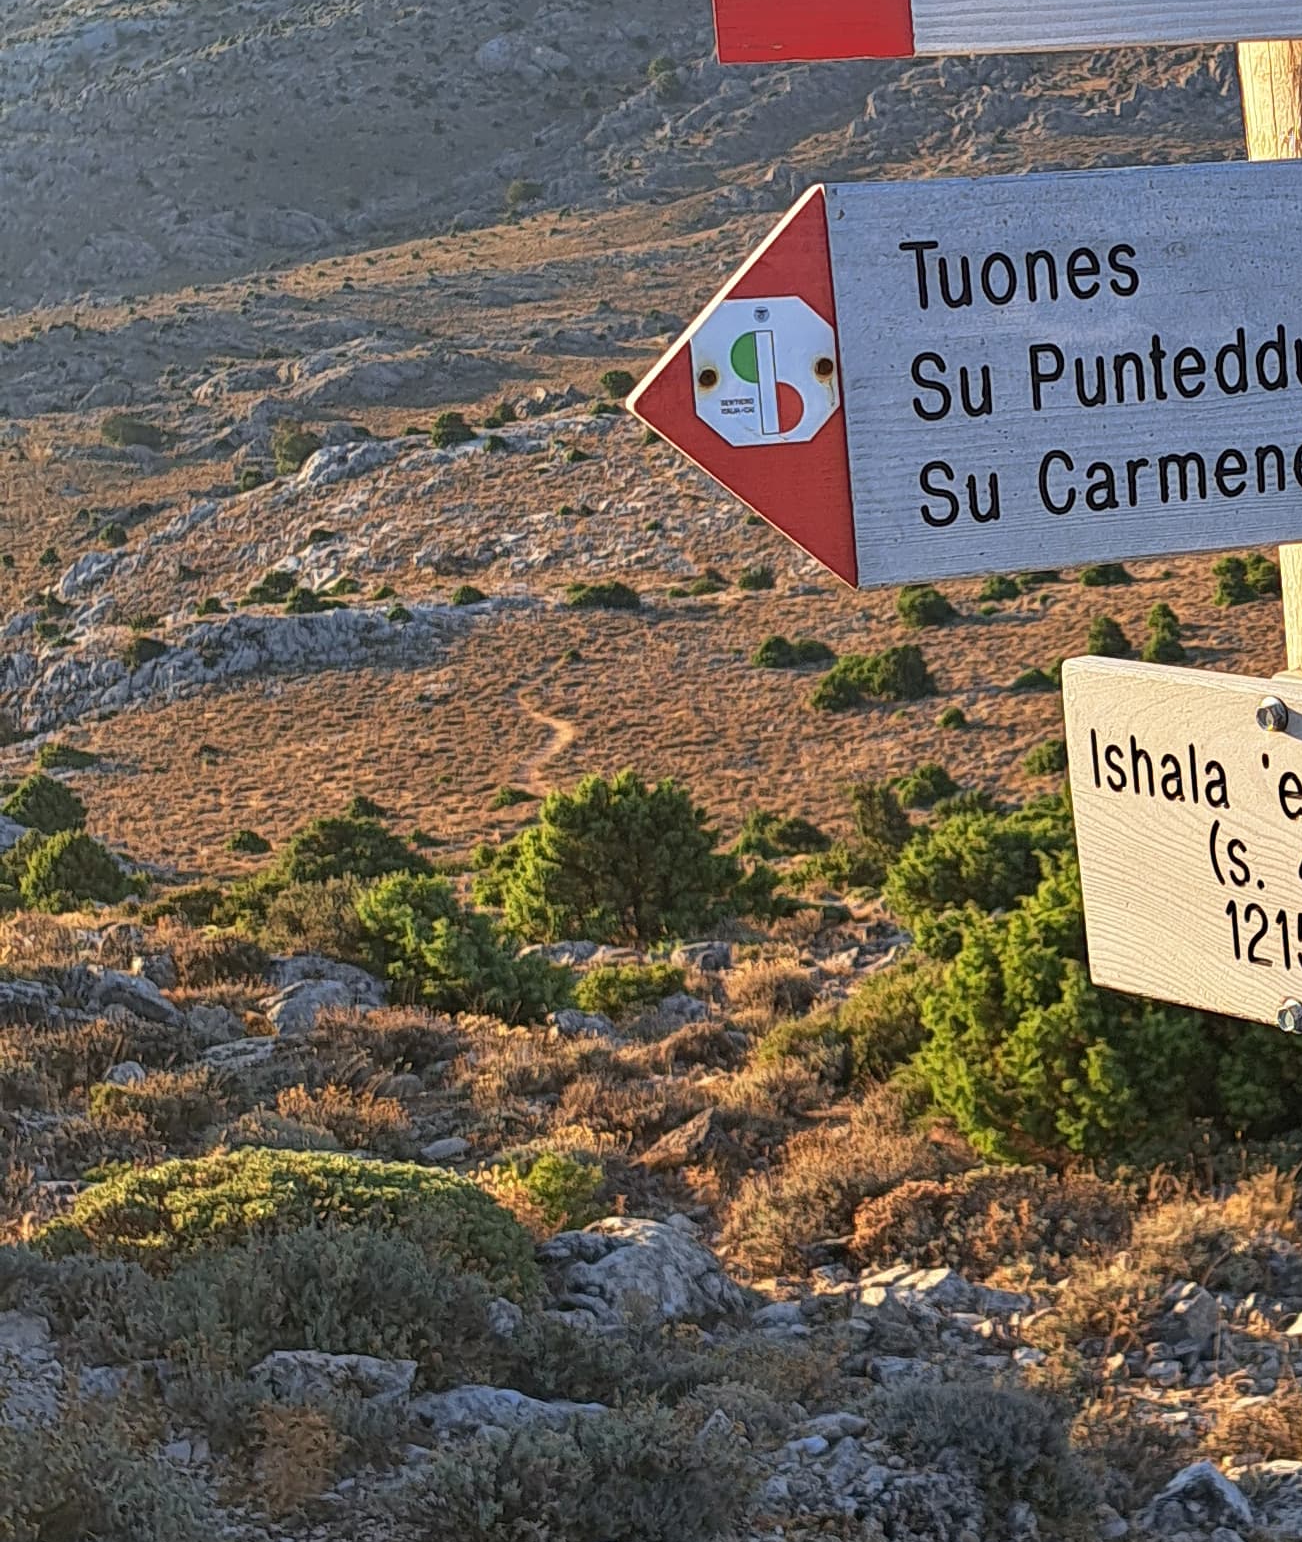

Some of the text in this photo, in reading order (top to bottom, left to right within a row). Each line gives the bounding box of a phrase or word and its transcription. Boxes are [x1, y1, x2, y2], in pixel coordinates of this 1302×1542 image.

[899, 240, 1140, 310] Tuones
[911, 351, 993, 422] Su
[919, 460, 1001, 528] Su
[1090, 728, 1230, 809] Ishala
[1209, 819, 1265, 890] (s.
